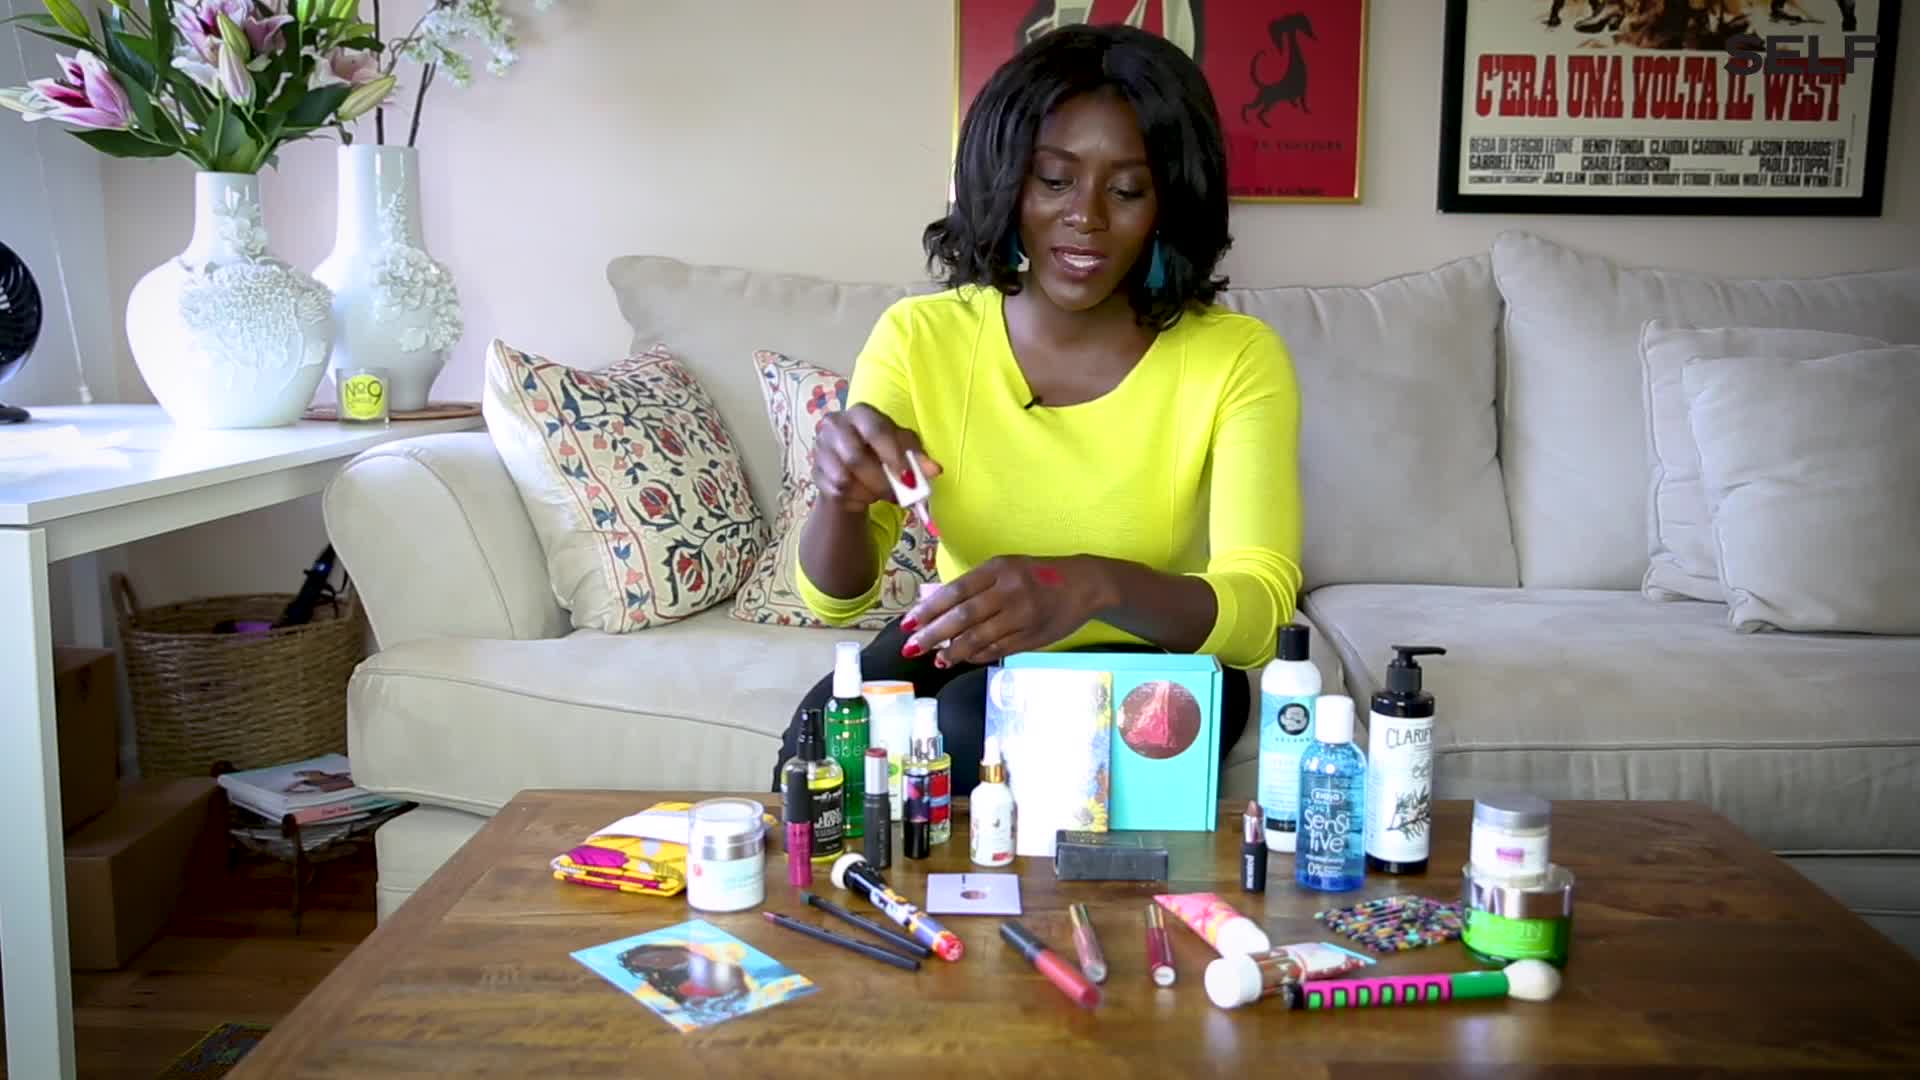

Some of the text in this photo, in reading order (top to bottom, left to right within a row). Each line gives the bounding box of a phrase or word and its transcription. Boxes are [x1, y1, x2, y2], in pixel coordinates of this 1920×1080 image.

[1476, 54, 1846, 121] C'ERA UNA VOLTA IL WEST
[1582, 139, 1612, 154] HENRY
